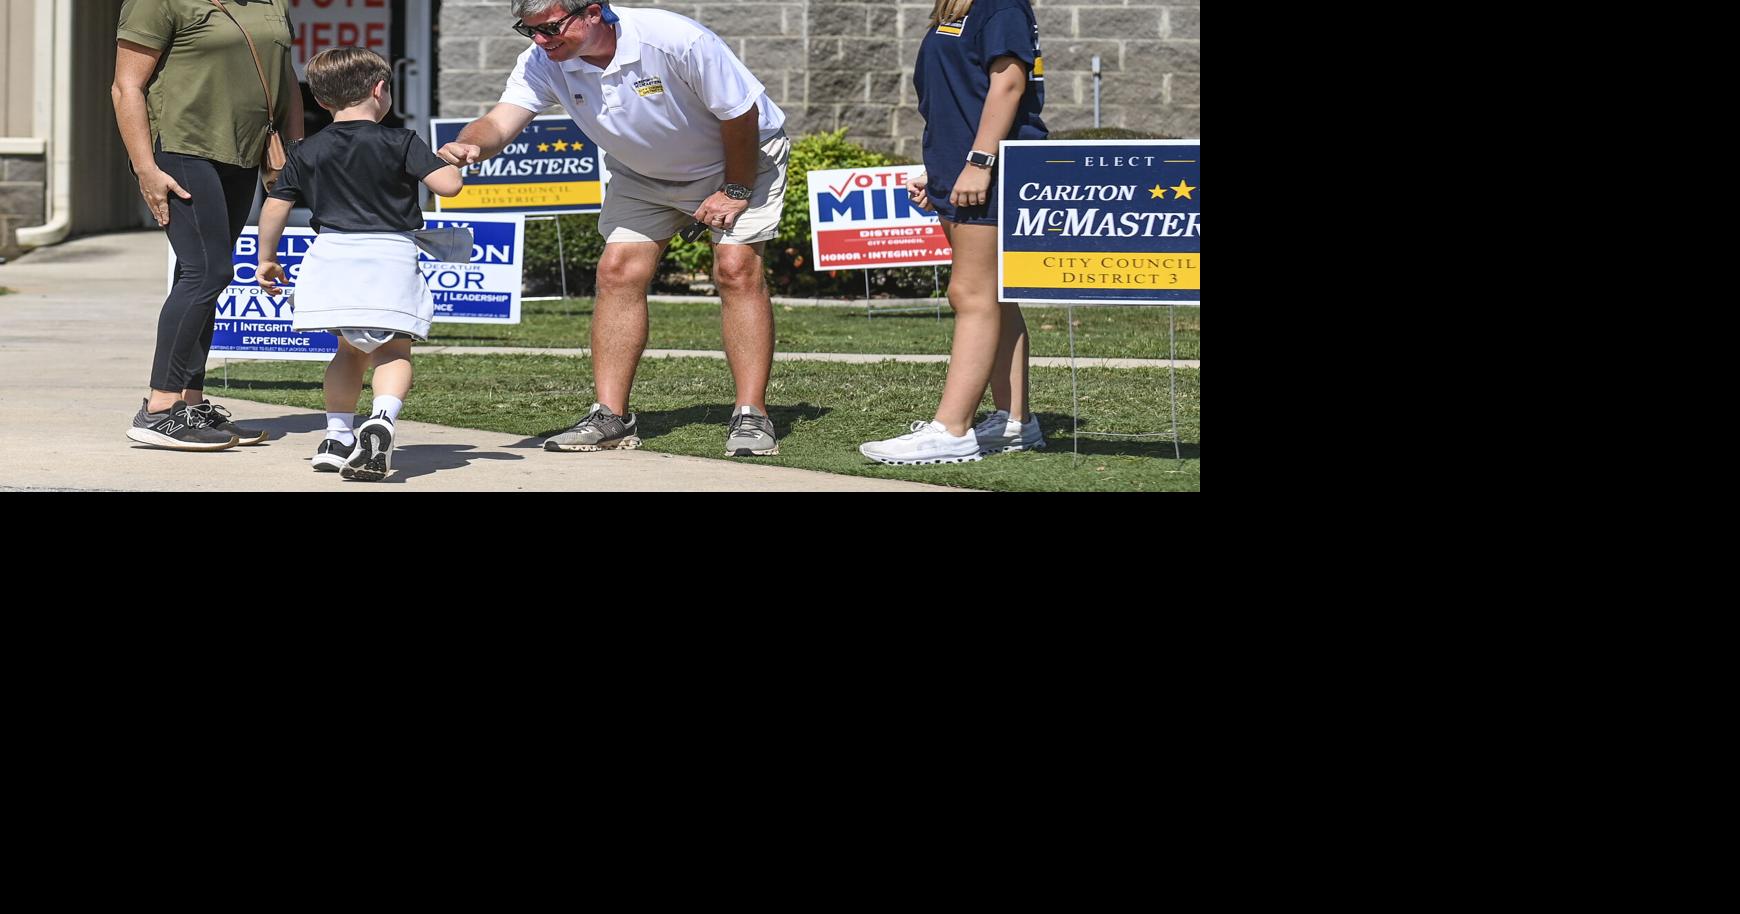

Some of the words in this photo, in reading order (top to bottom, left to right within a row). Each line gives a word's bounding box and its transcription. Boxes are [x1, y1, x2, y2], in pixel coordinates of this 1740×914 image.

[1084, 156, 1155, 167] ELECT
[1019, 182, 1138, 201] CARLTON
[817, 188, 939, 222] MIK
[860, 229, 923, 238] DISTRICT
[926, 227, 934, 236] 3
[888, 238, 925, 246] COUNCIL
[821, 253, 861, 262] HONOR
[868, 249, 927, 260] INTEGRITY
[1042, 257, 1092, 269] CITY
[1101, 257, 1197, 270] COUNCIL
[1062, 272, 1160, 285] DISTRICT
[1168, 273, 1178, 285] 3
[450, 292, 509, 303] LEADERSHIP
[243, 336, 311, 346] EXPERIENCE
